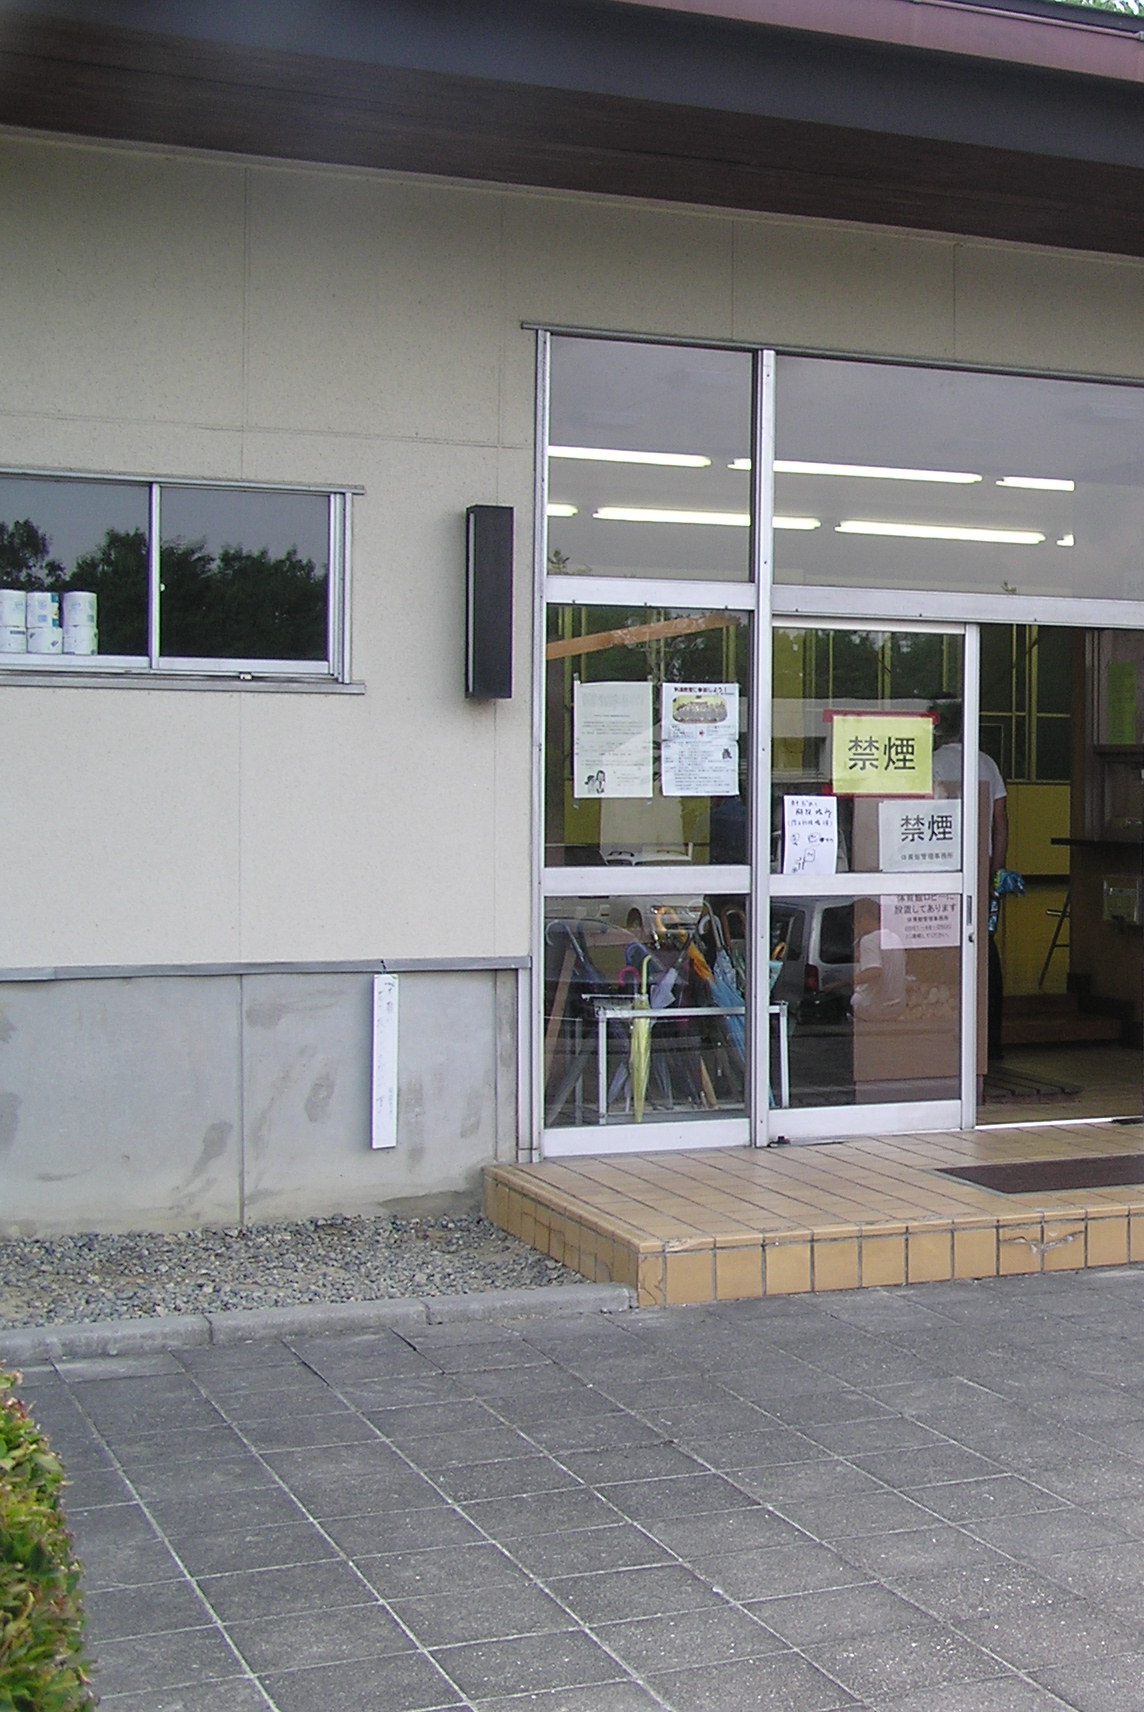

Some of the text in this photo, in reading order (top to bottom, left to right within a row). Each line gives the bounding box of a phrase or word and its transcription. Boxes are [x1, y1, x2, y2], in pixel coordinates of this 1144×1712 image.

[848, 736, 916, 771] 禁煙
[900, 814, 953, 842] 禁煙
[894, 904, 956, 914] 設置してあります
